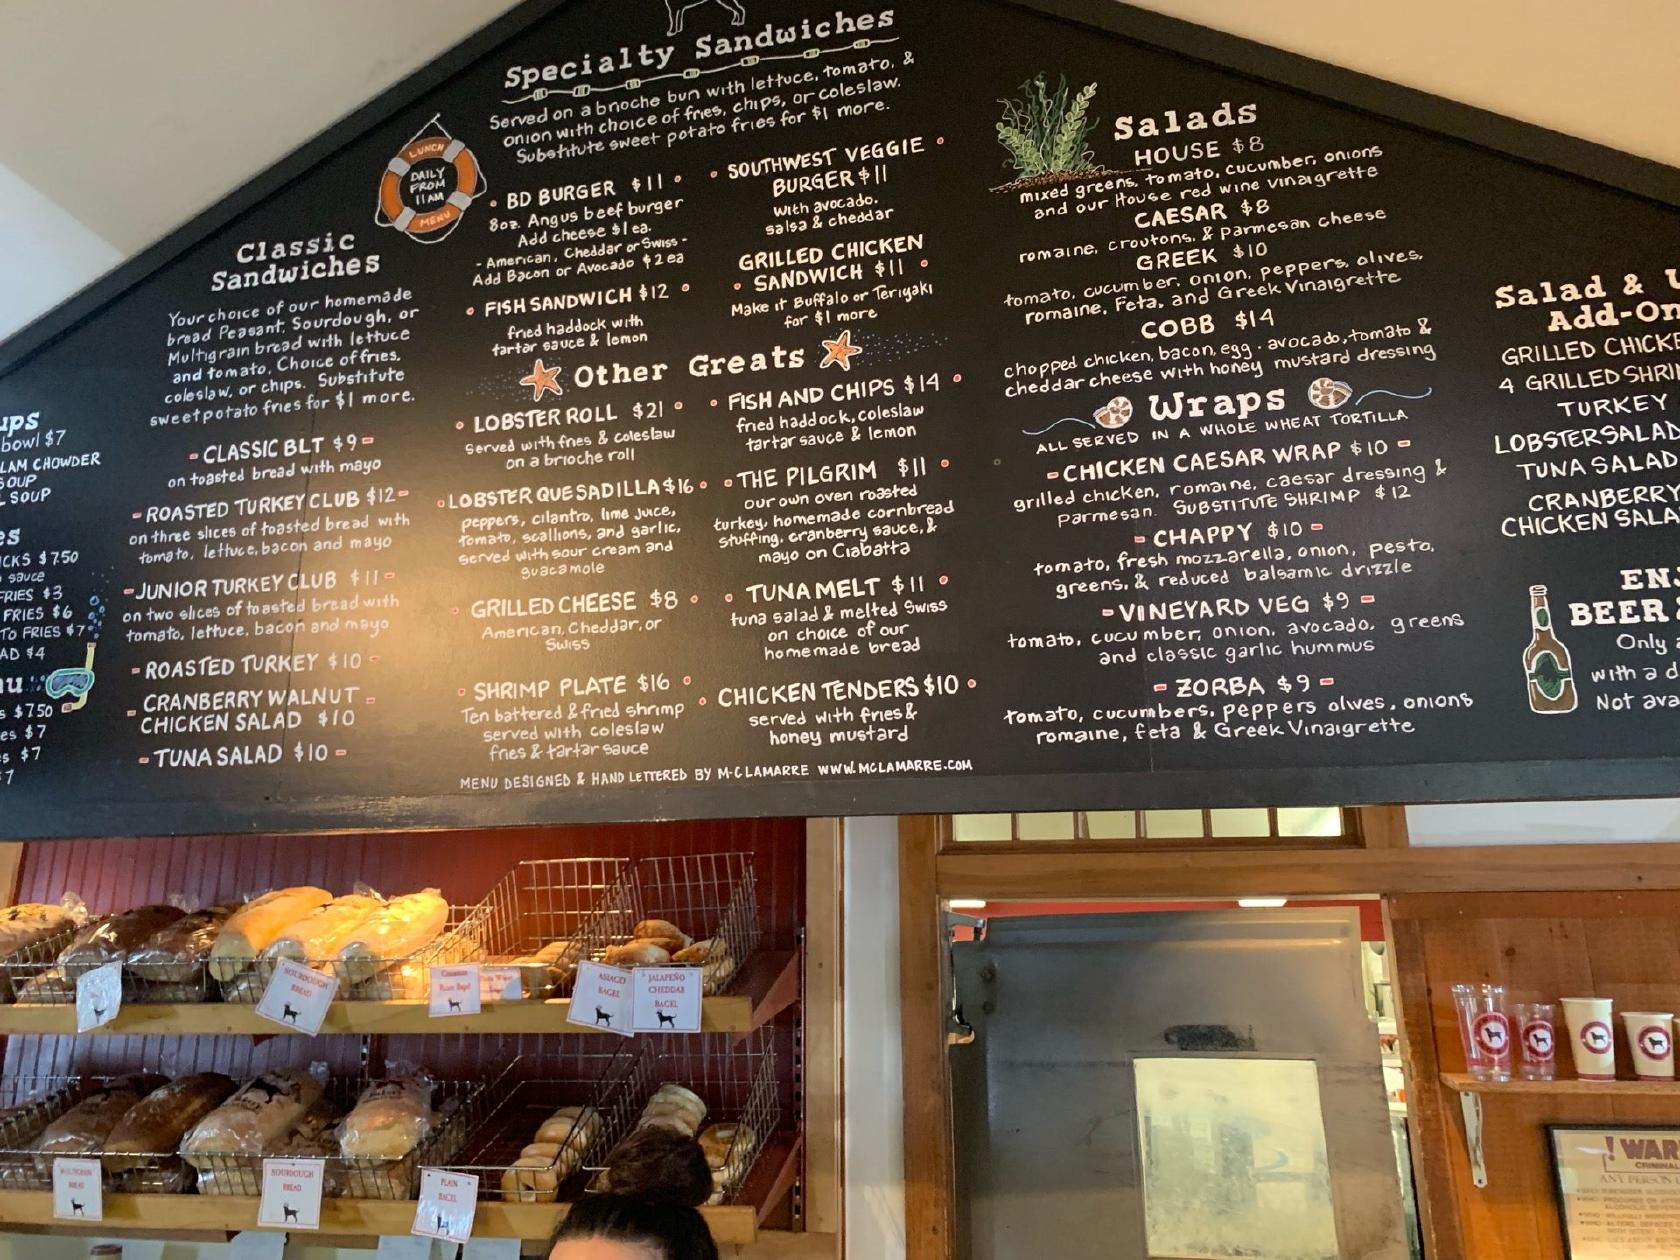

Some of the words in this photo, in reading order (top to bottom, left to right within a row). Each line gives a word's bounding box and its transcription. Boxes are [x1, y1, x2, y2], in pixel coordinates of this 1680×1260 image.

[505, 45, 674, 90] Specialty
[696, 10, 893, 58] Sandwiches
[517, 135, 605, 163] Substitute
[609, 132, 660, 150] sweet
[668, 123, 725, 147] potato
[731, 117, 775, 132] fries
[780, 110, 806, 126] for
[812, 106, 827, 120] $1
[1114, 102, 1256, 140] Salads
[409, 142, 445, 160] LUNCH
[728, 148, 836, 179] SOUTHWEST
[845, 137, 924, 162] VEGGIE
[1135, 141, 1220, 166] HOUSE
[1232, 136, 1264, 153] $8
[410, 179, 445, 193] FROM
[411, 167, 445, 181] DAILY
[773, 171, 855, 197] BURGER
[858, 165, 886, 185] $11
[508, 192, 531, 209] BD
[539, 181, 616, 206] BURGER
[632, 174, 662, 192] $11
[420, 212, 450, 226] MENU
[528, 212, 578, 228] Angus
[584, 202, 623, 220] beef
[628, 199, 683, 215] burger
[1135, 203, 1227, 228] CAESAR
[1241, 199, 1269, 216] $8
[237, 233, 354, 263] Classic
[739, 248, 823, 270] GRILLED
[832, 234, 922, 260] CHICKEN
[1137, 249, 1217, 270] GREEK
[1233, 242, 1267, 258] $10
[212, 255, 379, 291] Sandwiches
[754, 264, 862, 291] SANDWICH
[875, 259, 903, 277] $11
[486, 298, 525, 317] FISH
[530, 287, 631, 311] SANDWICH
[639, 284, 669, 301] $12
[1496, 275, 1606, 308] Salad
[1623, 274, 1644, 295] &
[1141, 314, 1214, 339] COBB
[1235, 309, 1273, 329] $14
[575, 363, 668, 387] Other
[689, 346, 804, 376] Greats
[1502, 341, 1596, 365] GRILLED
[729, 391, 772, 410] FISH
[778, 388, 823, 408] AND
[831, 379, 894, 401] CHIPS
[904, 373, 939, 394] $14
[1499, 378, 1513, 393] 4
[1526, 369, 1620, 391] GRILLED
[475, 409, 560, 433] LOBSTER
[566, 404, 617, 424] ROLL
[633, 401, 662, 419] $21
[1149, 389, 1284, 420] Wraps
[1557, 394, 1667, 416] TURKEY
[1, 432, 39, 452] bowl
[45, 430, 66, 447] $7
[1036, 441, 1068, 454] ALL
[1072, 432, 1138, 448] SERVED
[1152, 430, 1168, 440] IN
[1180, 428, 1190, 438] A
[1200, 422, 1256, 436] WHOLE
[1265, 416, 1321, 430] WHEAT
[1330, 410, 1408, 425] TORTILLA
[1495, 429, 1602, 454] LOBSTER
[33, 452, 100, 471] CHOWDER
[204, 439, 278, 463] CLASSIC
[284, 437, 324, 456] BLT
[333, 434, 357, 452] $9
[1063, 457, 1165, 482] CHICKEN
[1173, 448, 1265, 472] CAESAR
[1272, 442, 1340, 463] WRAP
[1350, 440, 1388, 456] $10
[737, 469, 778, 488] THE
[787, 461, 876, 486] PILGRIM
[898, 457, 925, 477] $11
[1516, 459, 1586, 480] TUNA
[1591, 450, 1677, 474] SALAD
[10, 488, 51, 504] SOUP
[146, 502, 228, 522] ROASTED
[235, 496, 307, 516] TURKEY
[310, 491, 360, 508] CLUB
[367, 486, 395, 505] $12
[449, 487, 533, 508] LOBSTER
[663, 477, 693, 494] $16
[1154, 522, 1252, 547] CHAPPY
[1268, 521, 1302, 539] $10
[1502, 512, 1608, 537] CHICKEN
[8, 571, 45, 583] sauce
[136, 580, 207, 600] JUNIOR
[212, 574, 284, 596] TURKEY
[287, 571, 336, 591] CLUB
[350, 569, 378, 586] $11
[746, 583, 811, 603] TUNA
[816, 578, 880, 599] MELT
[892, 575, 923, 595] $11
[4, 607, 43, 622] FRIES
[53, 605, 72, 619] $6
[471, 598, 554, 618] GRILLED
[559, 591, 636, 613] CHEESE
[650, 589, 678, 609] $8
[1119, 599, 1249, 622] VINEYARD
[1258, 596, 1309, 614] VEG
[1323, 592, 1349, 612] $9
[1569, 599, 1669, 626] BEER
[1616, 633, 1667, 655] Only
[145, 660, 235, 680] ROASTED
[241, 654, 318, 673] TURKEY
[328, 653, 361, 670] $10
[143, 690, 264, 713] CRANBERRY
[268, 687, 360, 707] WALNUT
[474, 680, 550, 701] SHRIMP
[560, 675, 626, 696] PLATE
[637, 673, 669, 692] $16
[719, 683, 816, 707] CHICKEN
[821, 676, 919, 700] TENDERS
[924, 674, 958, 696] $10
[1176, 677, 1265, 697] ZORBA
[1277, 675, 1309, 693] $9
[141, 712, 228, 734] CHICKEN
[235, 711, 301, 731] SALAD
[319, 710, 354, 727] $10
[154, 748, 212, 767] TUNA
[217, 744, 282, 766] SALAD
[294, 741, 327, 762] $10
[461, 776, 498, 789] MENU
[505, 774, 571, 790] DESIGNED
[577, 772, 585, 785] &
[592, 772, 624, 785] HAND
[695, 768, 711, 780] BY
